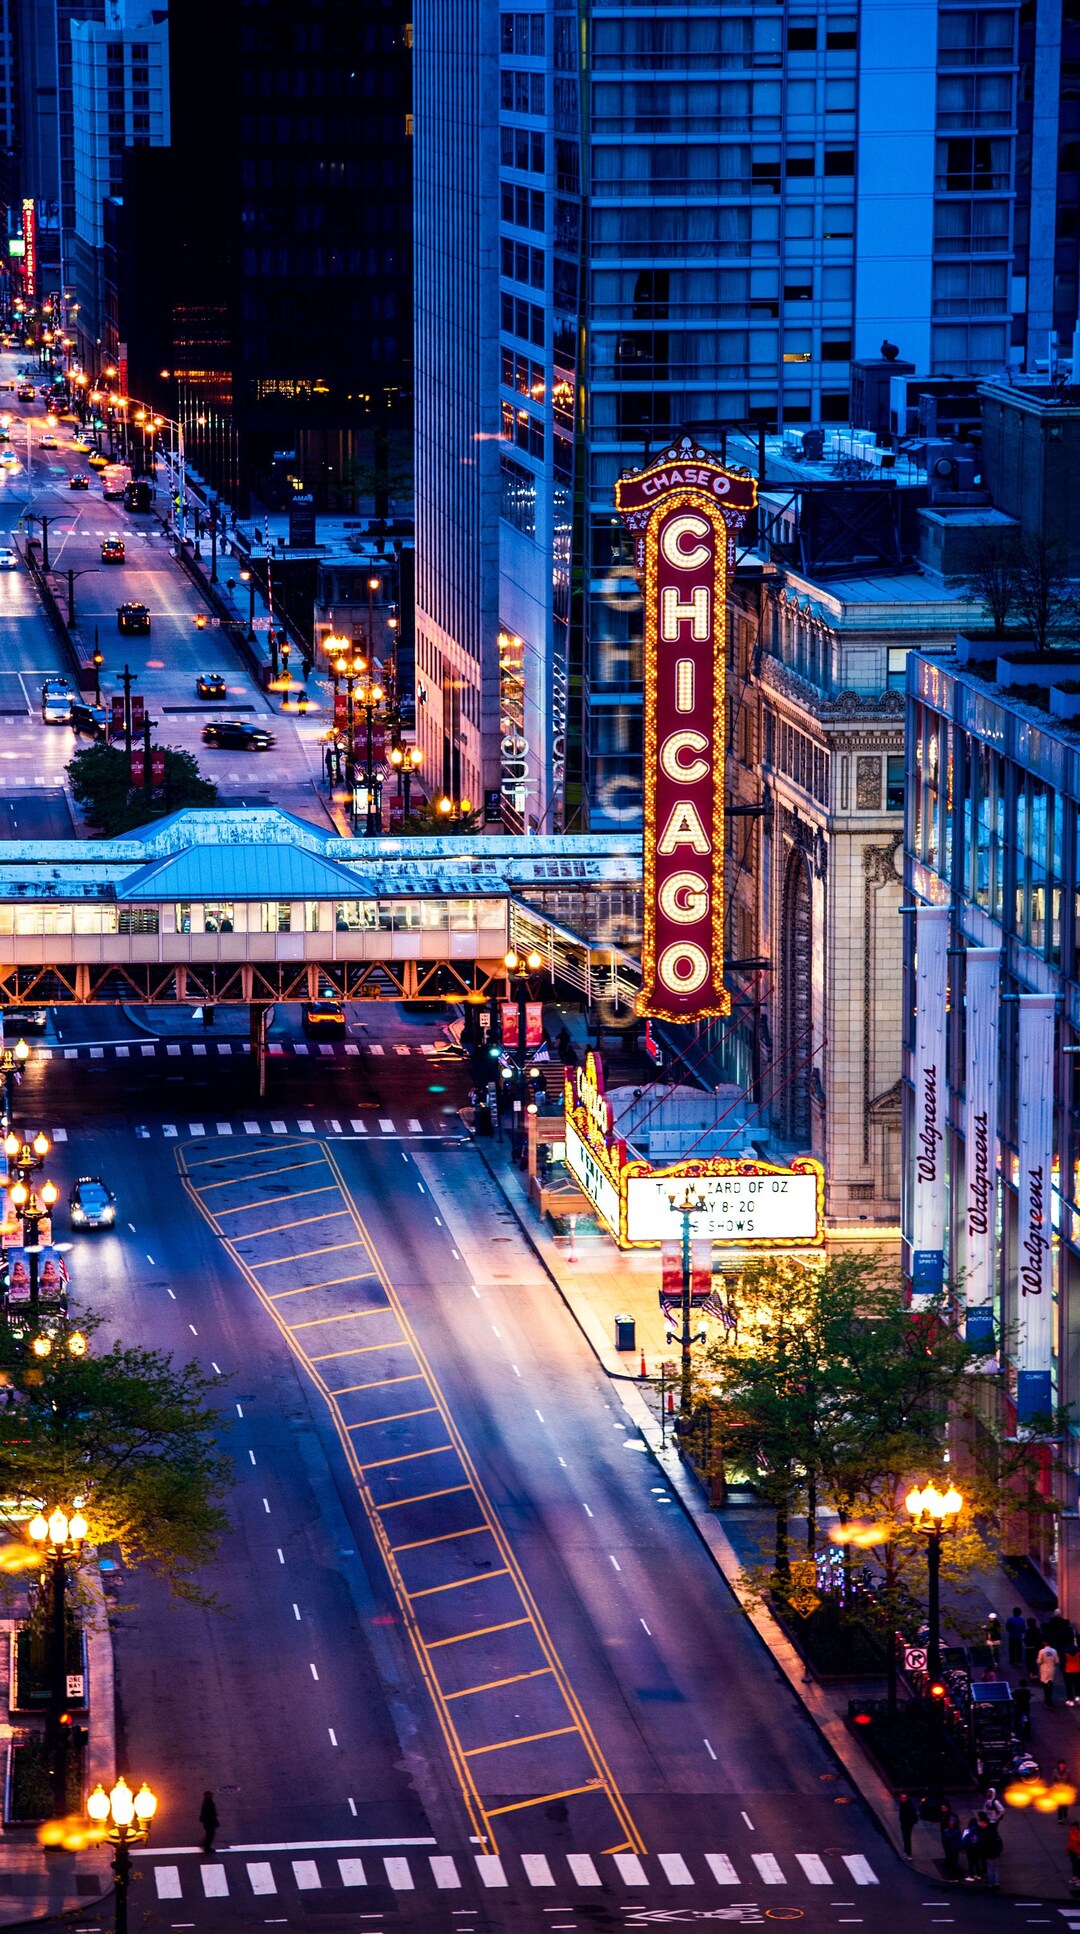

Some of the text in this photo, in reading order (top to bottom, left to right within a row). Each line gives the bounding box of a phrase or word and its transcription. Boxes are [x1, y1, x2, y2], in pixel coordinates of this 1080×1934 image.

[642, 469, 711, 496] CHASE
[658, 514, 711, 995] CHICAGO
[917, 1064, 943, 1184] Walgreens
[969, 1111, 994, 1237] Walgreens
[689, 1182, 741, 1194] WZARD
[748, 1182, 764, 1193] OF
[772, 1181, 788, 1193] OZ
[709, 1220, 755, 1231] SHOWS
[1021, 1165, 1049, 1298] Walgreens
